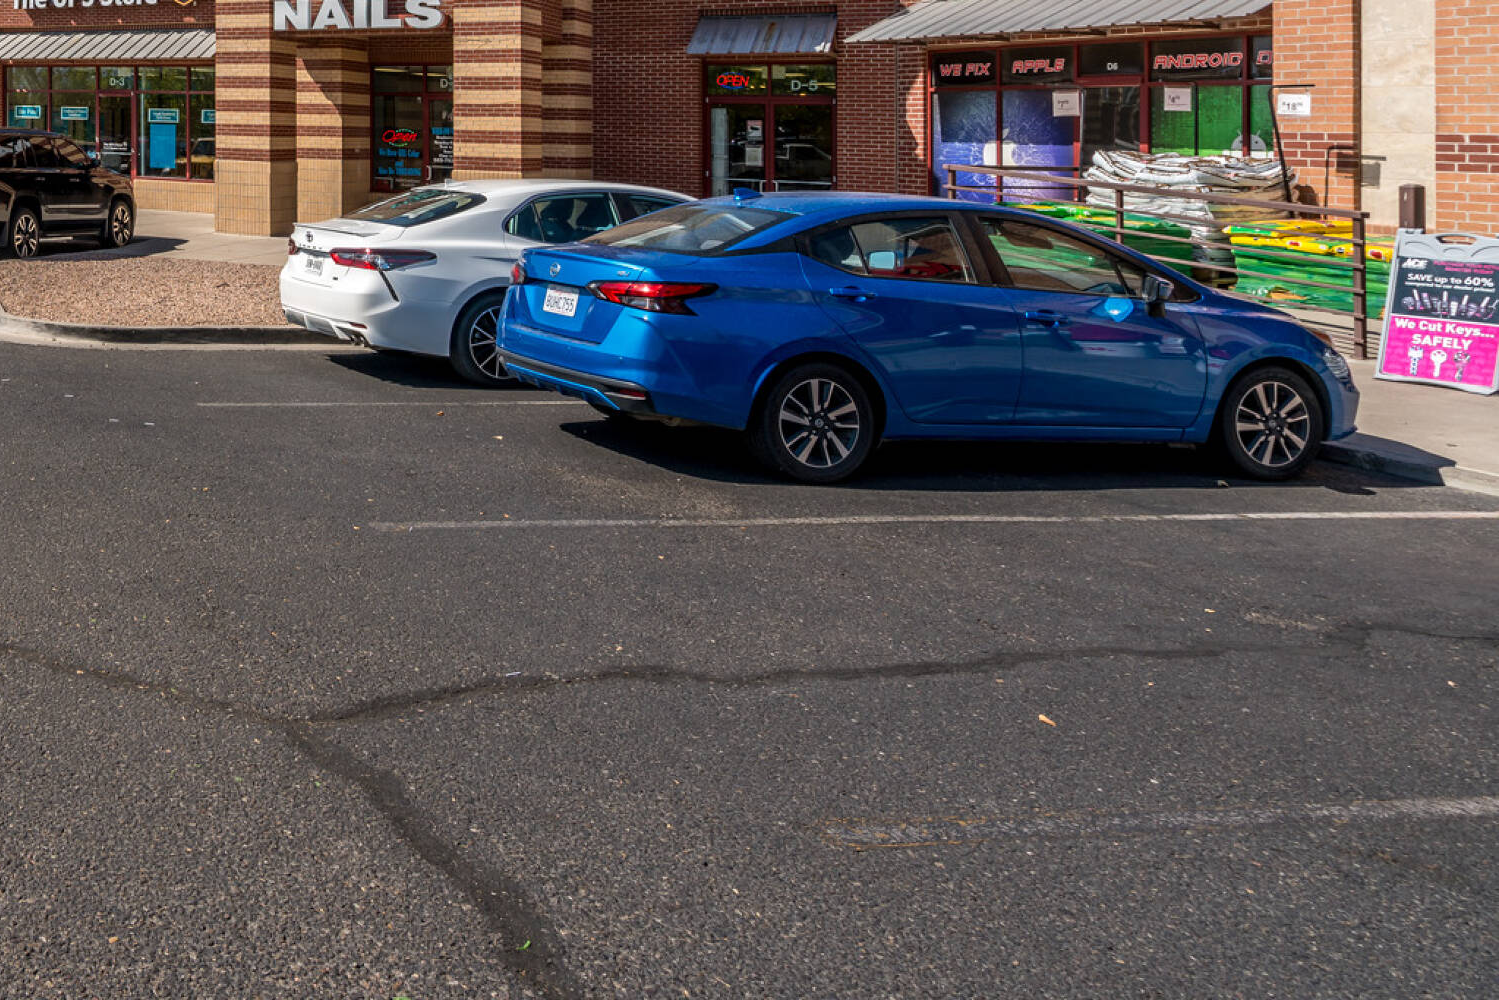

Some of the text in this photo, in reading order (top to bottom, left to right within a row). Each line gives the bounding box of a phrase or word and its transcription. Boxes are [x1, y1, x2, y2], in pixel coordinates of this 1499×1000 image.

[1012, 58, 1065, 74] APPLE
[1153, 52, 1244, 70] ANDROID
[939, 64, 962, 77] WE
[716, 74, 750, 87] OPEN
[791, 80, 819, 91] D-5
[1401, 258, 1428, 270] ACE
[1407, 273, 1434, 282] SAVE
[1464, 276, 1494, 288] 60%
[1395, 317, 1495, 338] We Cut Keys...
[1411, 333, 1473, 350] SAFELY
